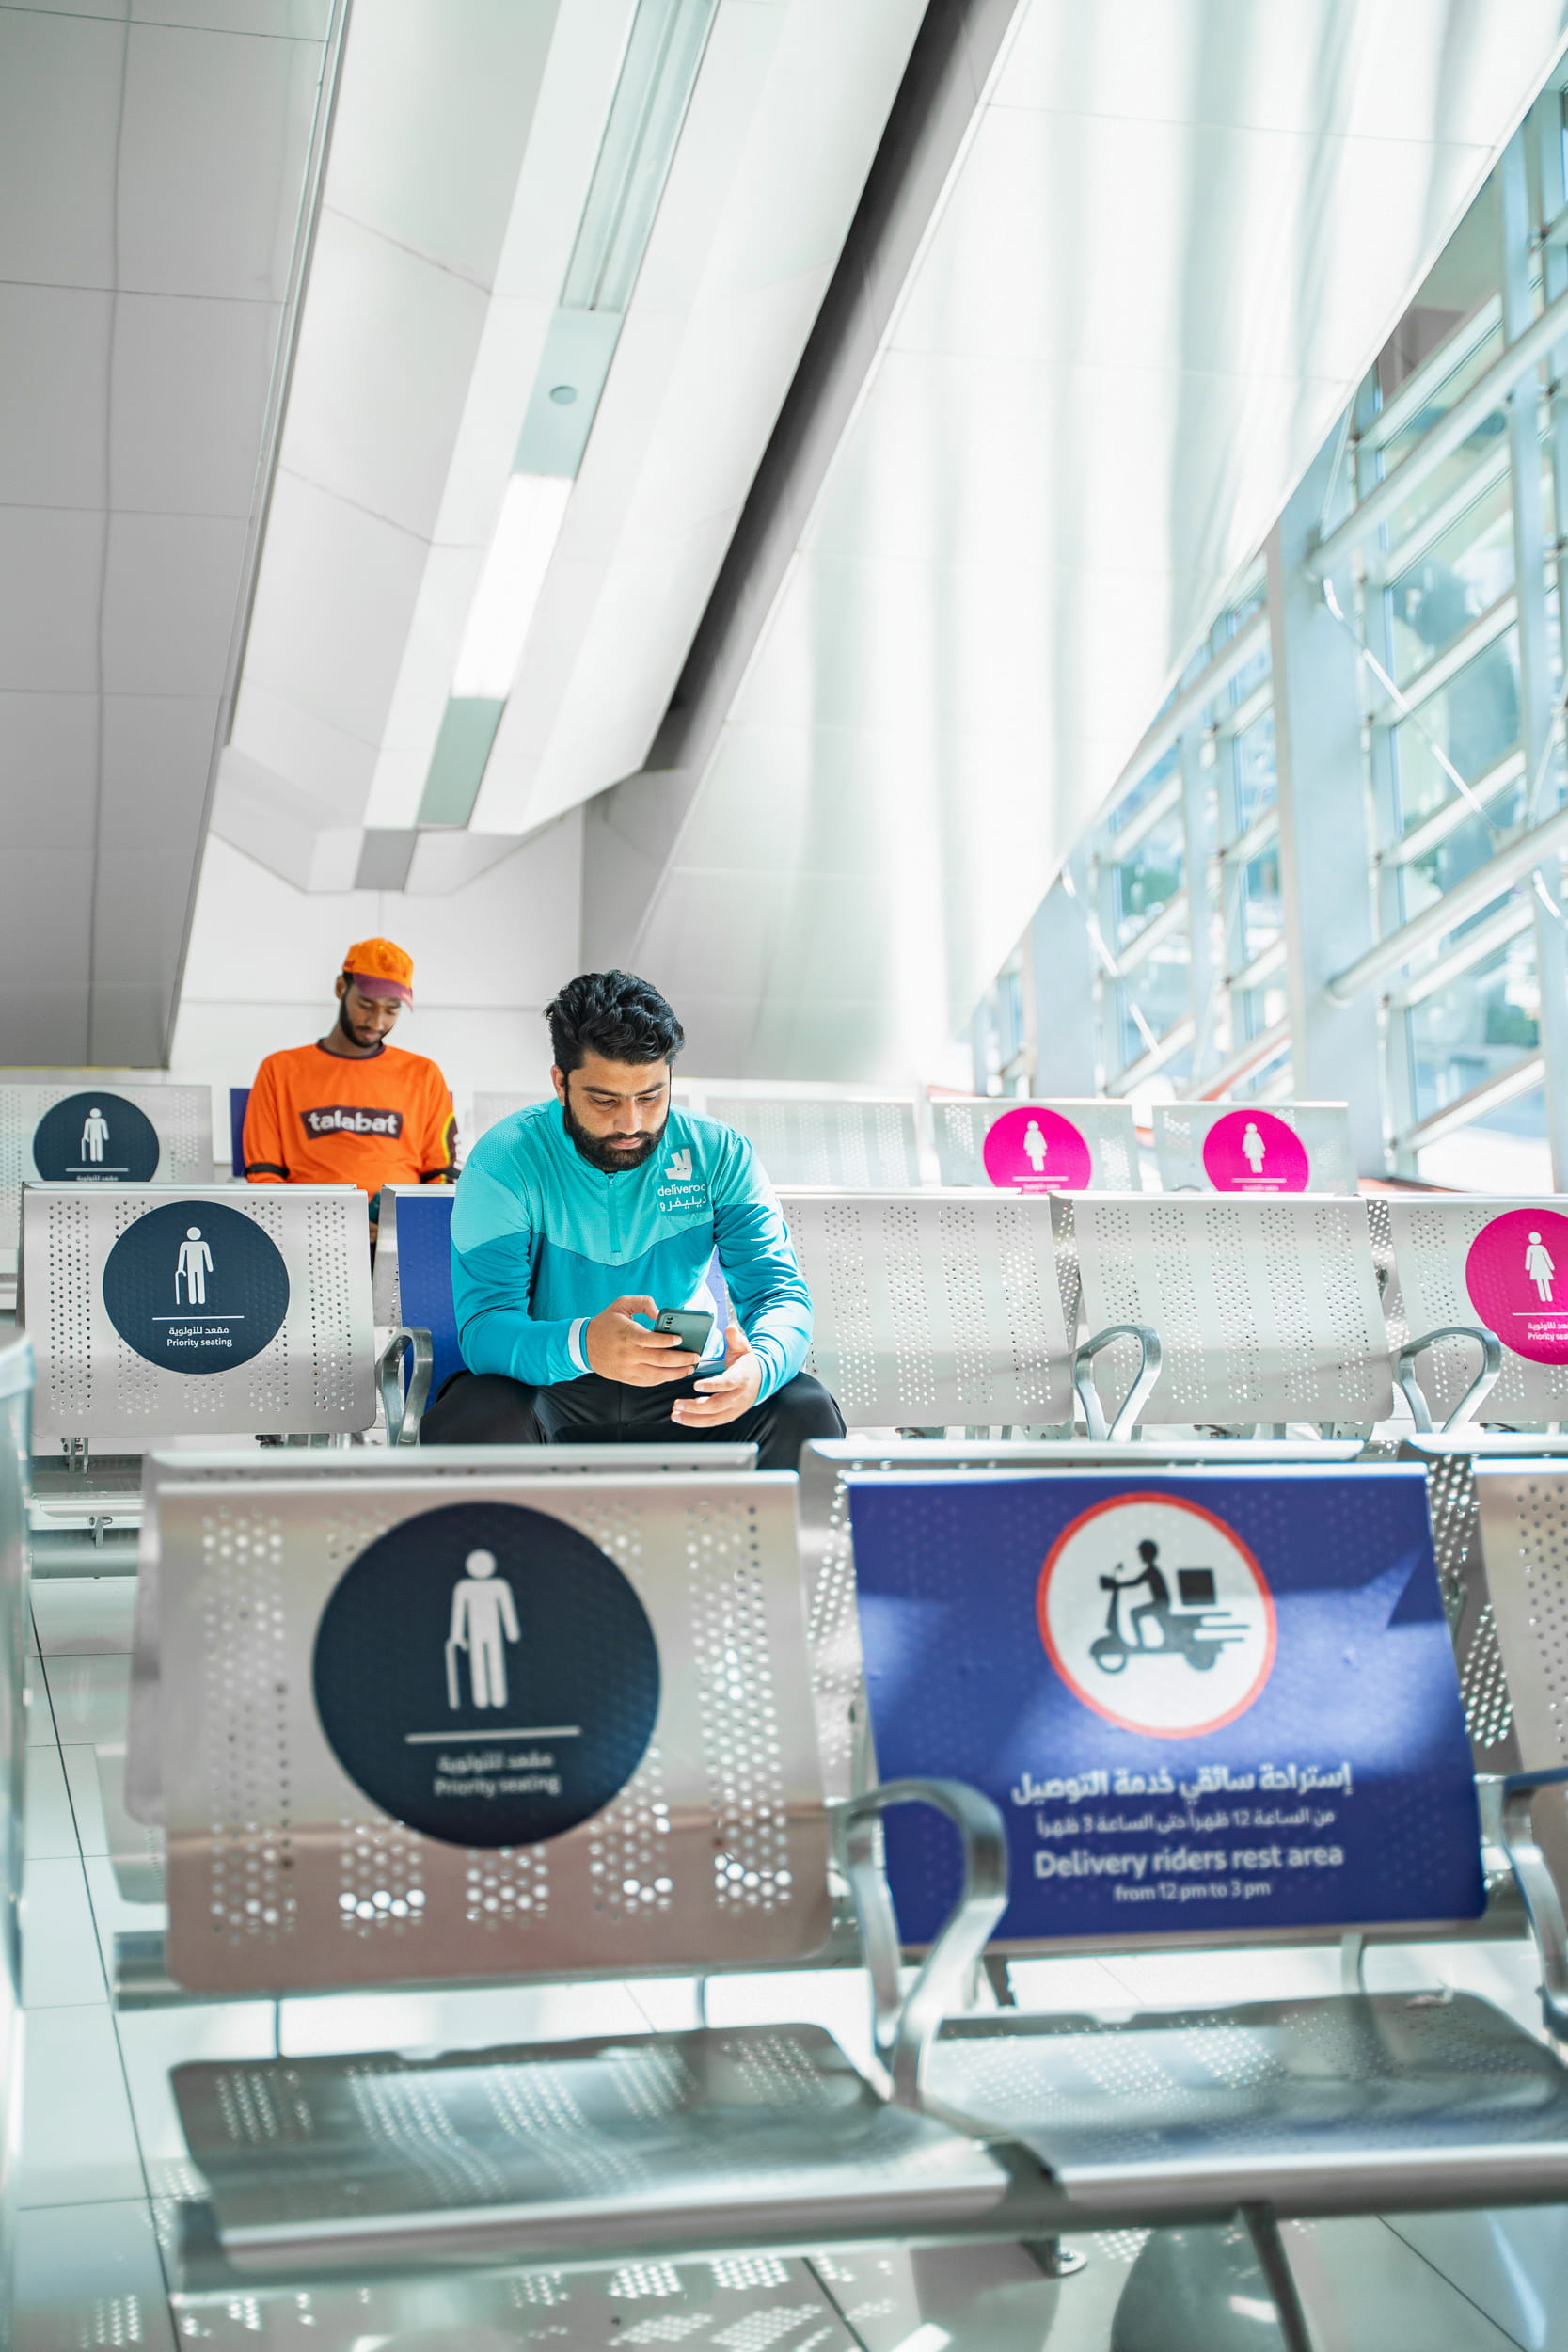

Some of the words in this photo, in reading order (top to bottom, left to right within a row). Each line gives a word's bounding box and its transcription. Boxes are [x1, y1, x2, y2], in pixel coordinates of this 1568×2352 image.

[308, 1110, 398, 1135] talabat
[657, 1184, 706, 1197] deliveroo
[659, 1195, 707, 1212] ديليفرو
[168, 1326, 203, 1337] للأولوية
[1527, 1332, 1555, 1342] Priority
[166, 1338, 198, 1348] Priority
[200, 1338, 232, 1347] seating
[434, 1775, 495, 1798] Priority
[499, 1774, 562, 1796] seating
[1011, 1770, 1109, 1805] التوصيل
[1113, 1767, 1175, 1796] خدمة
[1179, 1764, 1255, 1805] سائقي
[1260, 1761, 1353, 1796] إستراحة
[1083, 1813, 1093, 1833] 3
[1097, 1812, 1153, 1832] الساعة
[1157, 1813, 1186, 1834] حتى
[1232, 1809, 1250, 1826] 12
[1254, 1808, 1310, 1826] الساعة
[1314, 1809, 1336, 1828] من
[1035, 1850, 1148, 1879] Delivery
[1152, 1847, 1227, 1873] riders
[1233, 1846, 1282, 1869] rest
[1288, 1845, 1343, 1867] area
[1115, 1884, 1155, 1901] from
[1159, 1883, 1176, 1899] 12
[1180, 1885, 1207, 1902] pm
[1210, 1883, 1227, 1898] to
[1231, 1880, 1241, 1897] 3
[1244, 1883, 1271, 1899] pm
